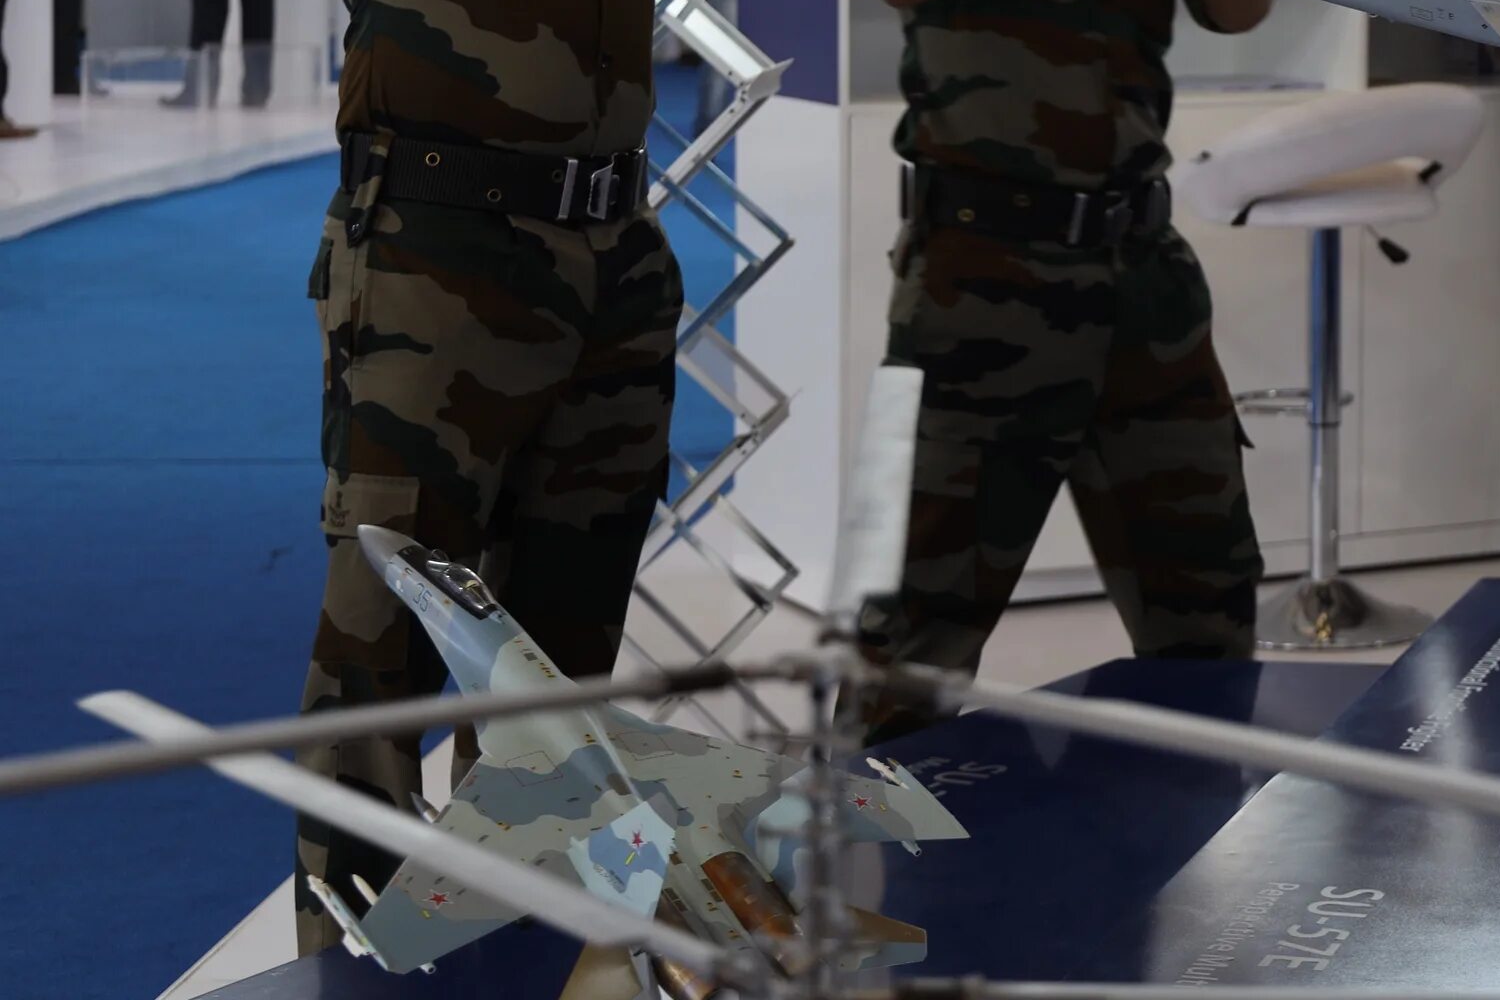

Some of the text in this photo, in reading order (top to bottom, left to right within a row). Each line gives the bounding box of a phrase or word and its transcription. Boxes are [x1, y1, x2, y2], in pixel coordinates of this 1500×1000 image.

[412, 582, 433, 613] 35
[1206, 881, 1301, 953] Perspective
[1256, 885, 1386, 972] SU-57E
